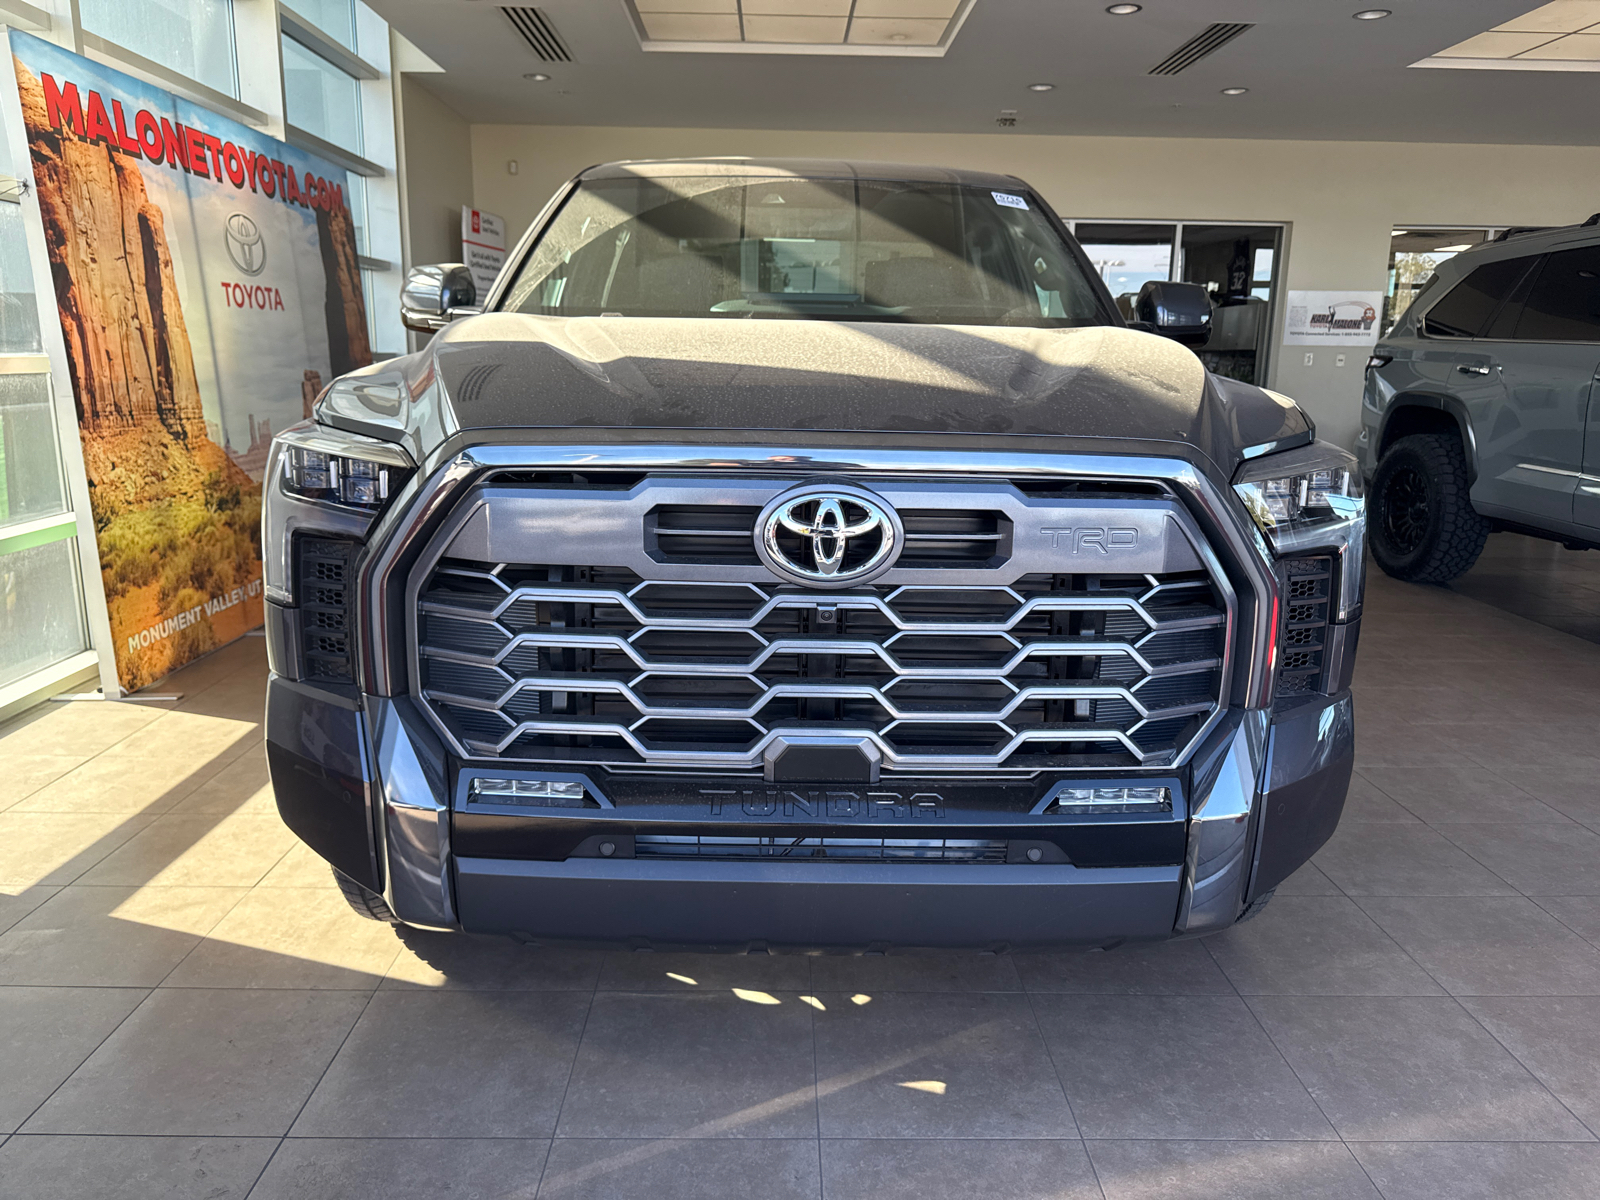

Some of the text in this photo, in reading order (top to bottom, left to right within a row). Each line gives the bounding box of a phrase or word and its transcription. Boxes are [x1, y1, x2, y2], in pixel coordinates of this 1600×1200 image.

[40, 71, 346, 216] MALONETOYOTA.COM
[1231, 271, 1246, 290] 32
[221, 281, 285, 311] TOYOTA
[1310, 314, 1330, 323] KARL
[1332, 319, 1362, 329] MALONE
[1040, 527, 1139, 555] TRD
[128, 579, 261, 653] MONUMENT VALLEY, UT
[699, 789, 946, 818] TUNDRA
